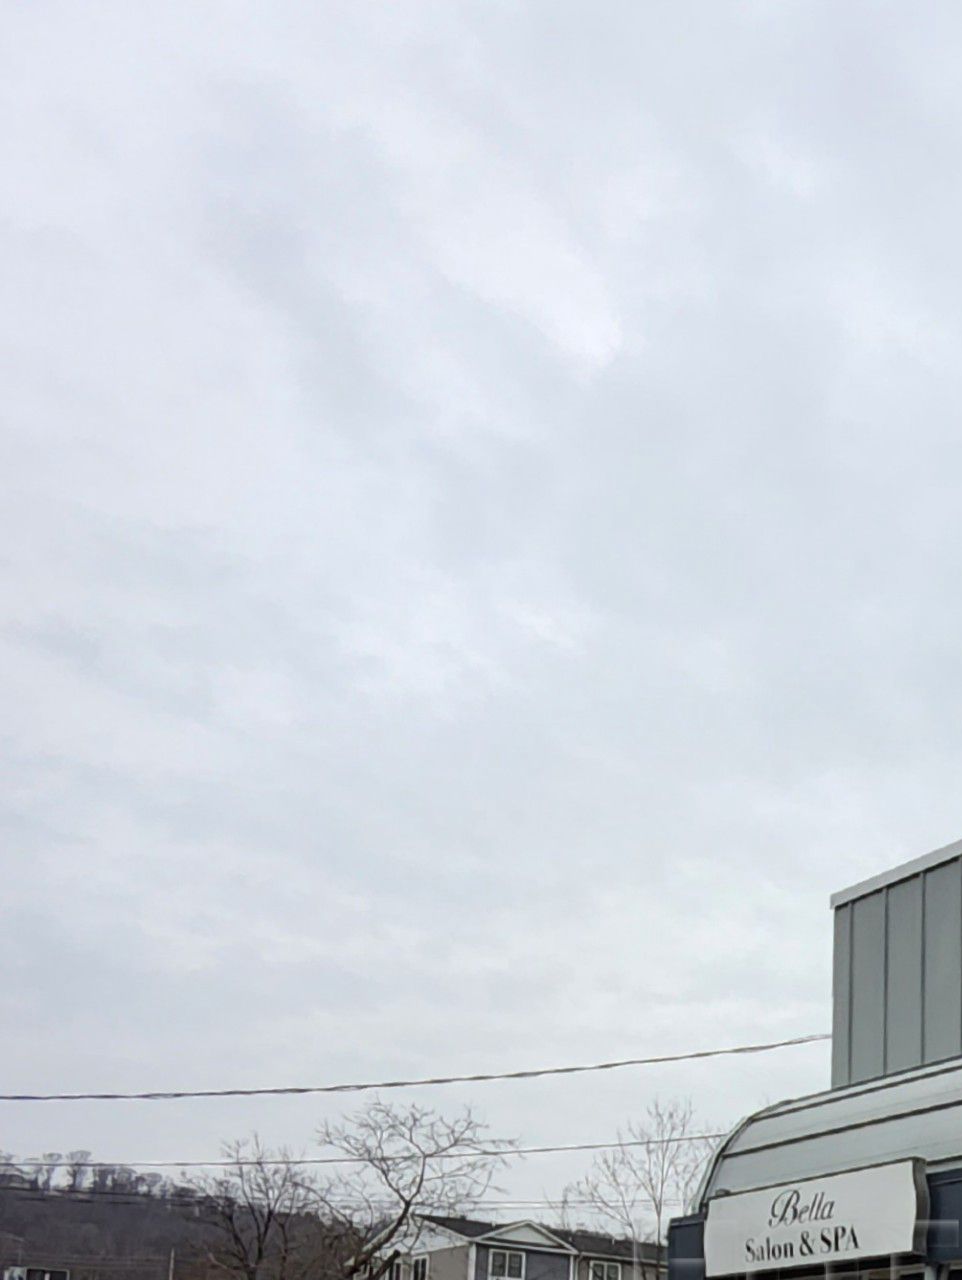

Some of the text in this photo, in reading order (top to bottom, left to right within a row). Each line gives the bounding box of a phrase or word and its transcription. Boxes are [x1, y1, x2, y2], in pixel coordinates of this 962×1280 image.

[768, 1189, 835, 1228] Bella
[745, 1225, 860, 1264] Salon & SPA
